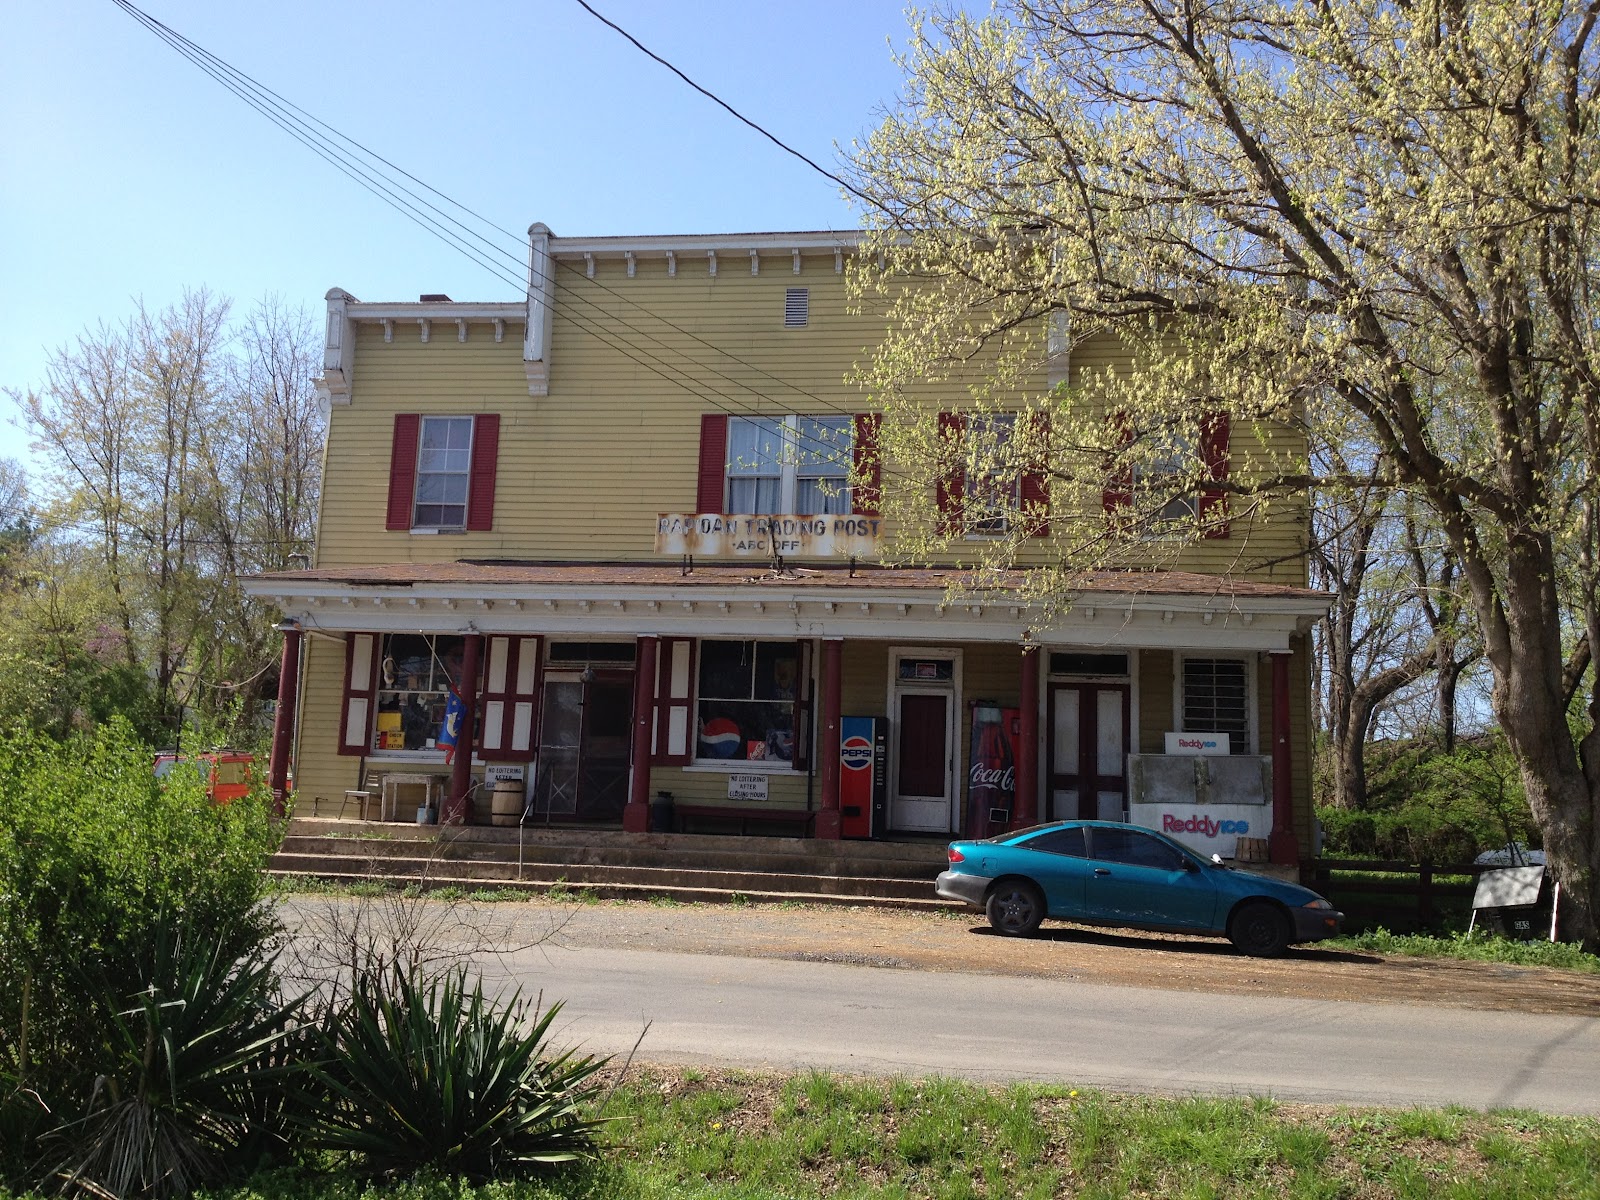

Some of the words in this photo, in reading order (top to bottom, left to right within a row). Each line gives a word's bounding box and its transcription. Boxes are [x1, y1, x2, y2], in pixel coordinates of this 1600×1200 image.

[744, 518, 827, 536] TRADING
[833, 519, 880, 537] POST
[736, 540, 766, 550] ABC
[774, 540, 800, 551] OFF
[841, 749, 872, 758] PEPSI
[738, 775, 766, 783] LOITERING
[750, 791, 766, 799] HOURS
